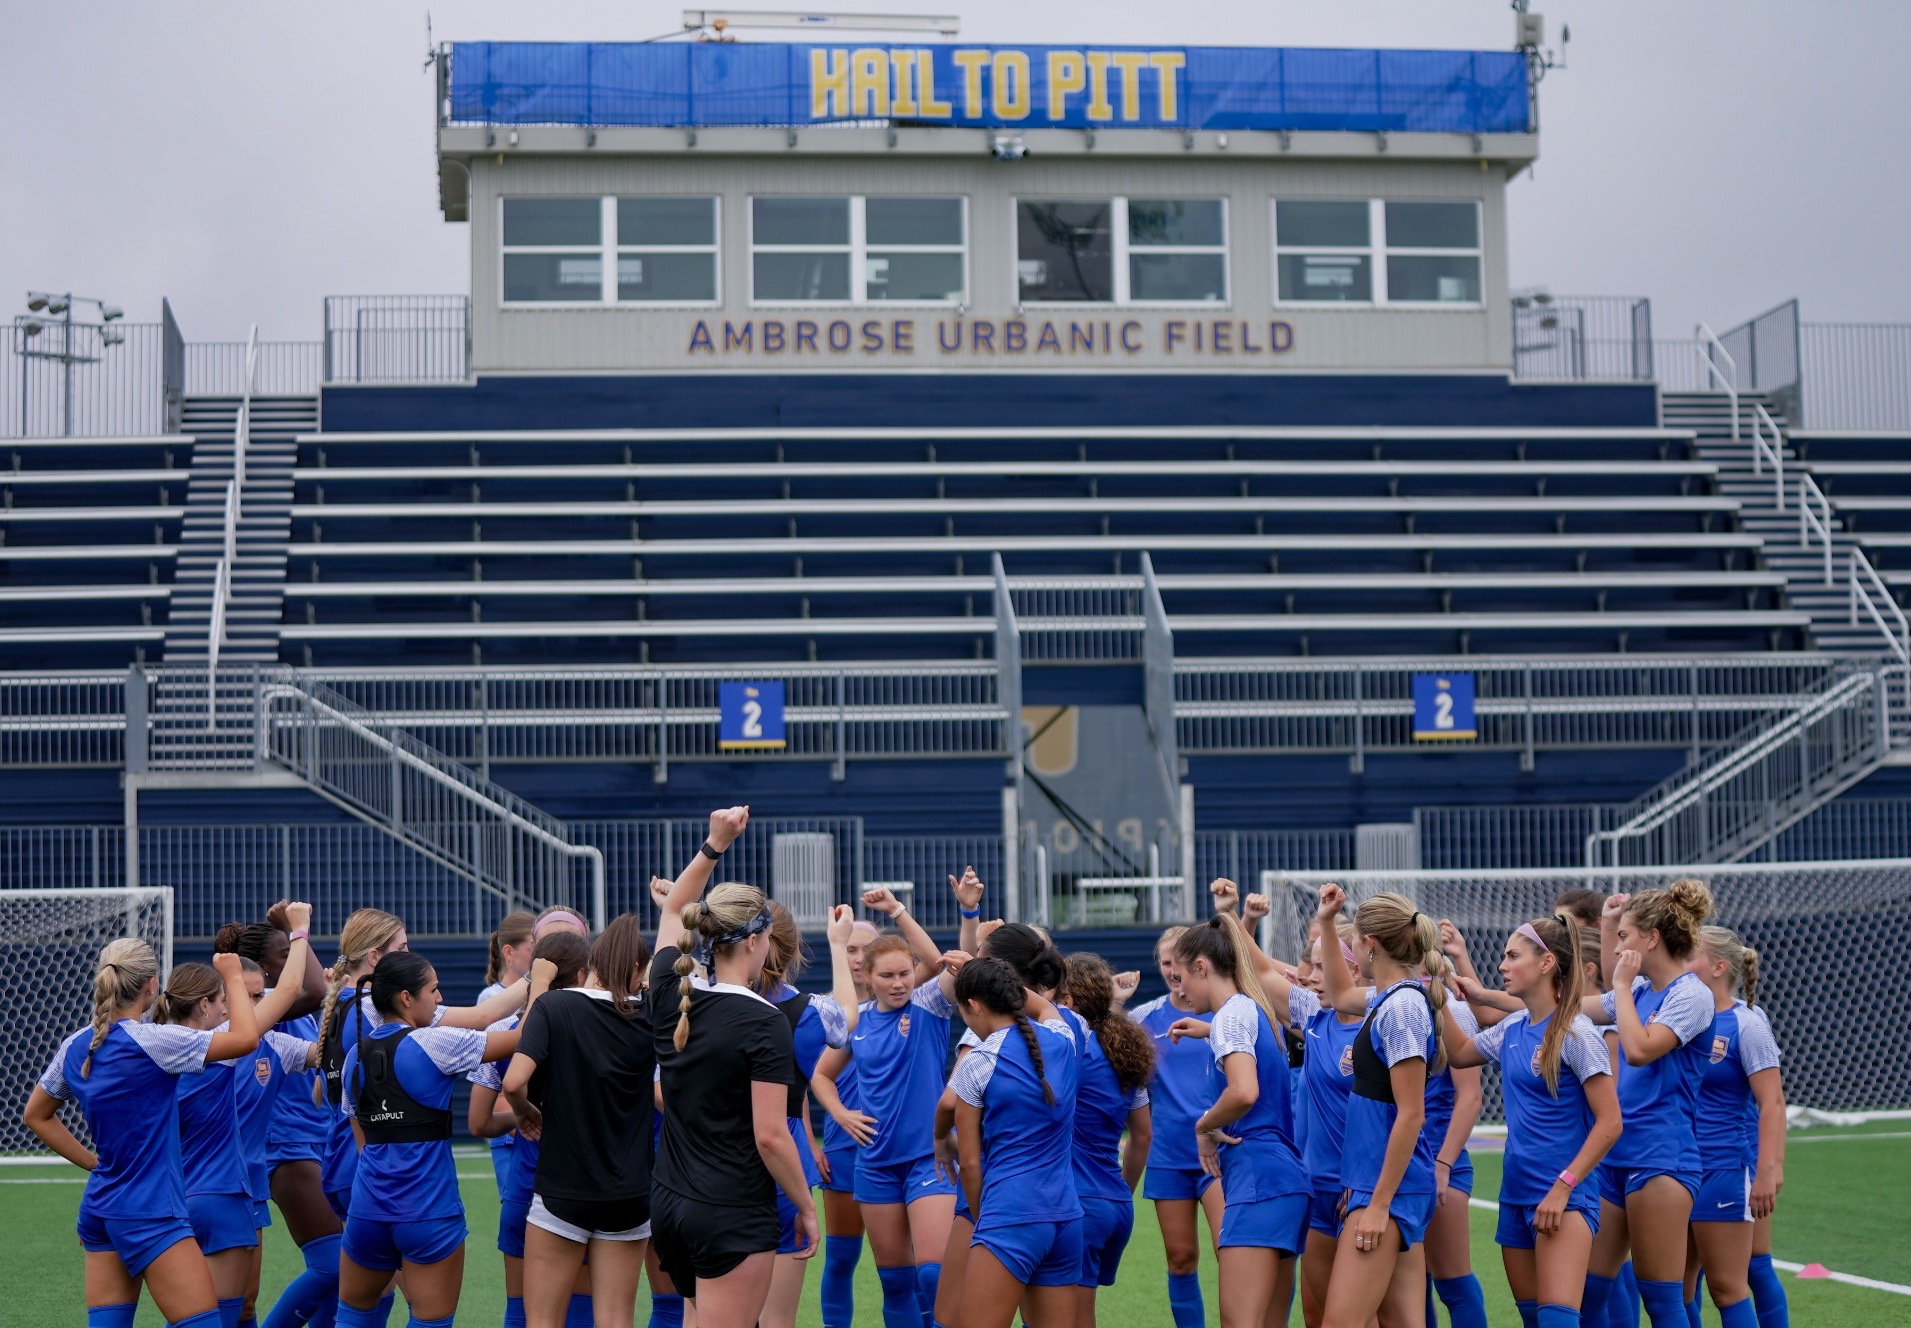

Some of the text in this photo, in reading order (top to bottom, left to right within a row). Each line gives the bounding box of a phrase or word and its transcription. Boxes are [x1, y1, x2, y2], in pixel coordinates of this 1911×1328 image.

[810, 48, 1186, 121] HAIL TO PITT
[688, 319, 1295, 354] AMBROSE URBANIC FIELD
[743, 700, 762, 737] 2
[1436, 692, 1454, 728] 2
[370, 1111, 404, 1122] CATAPULT
